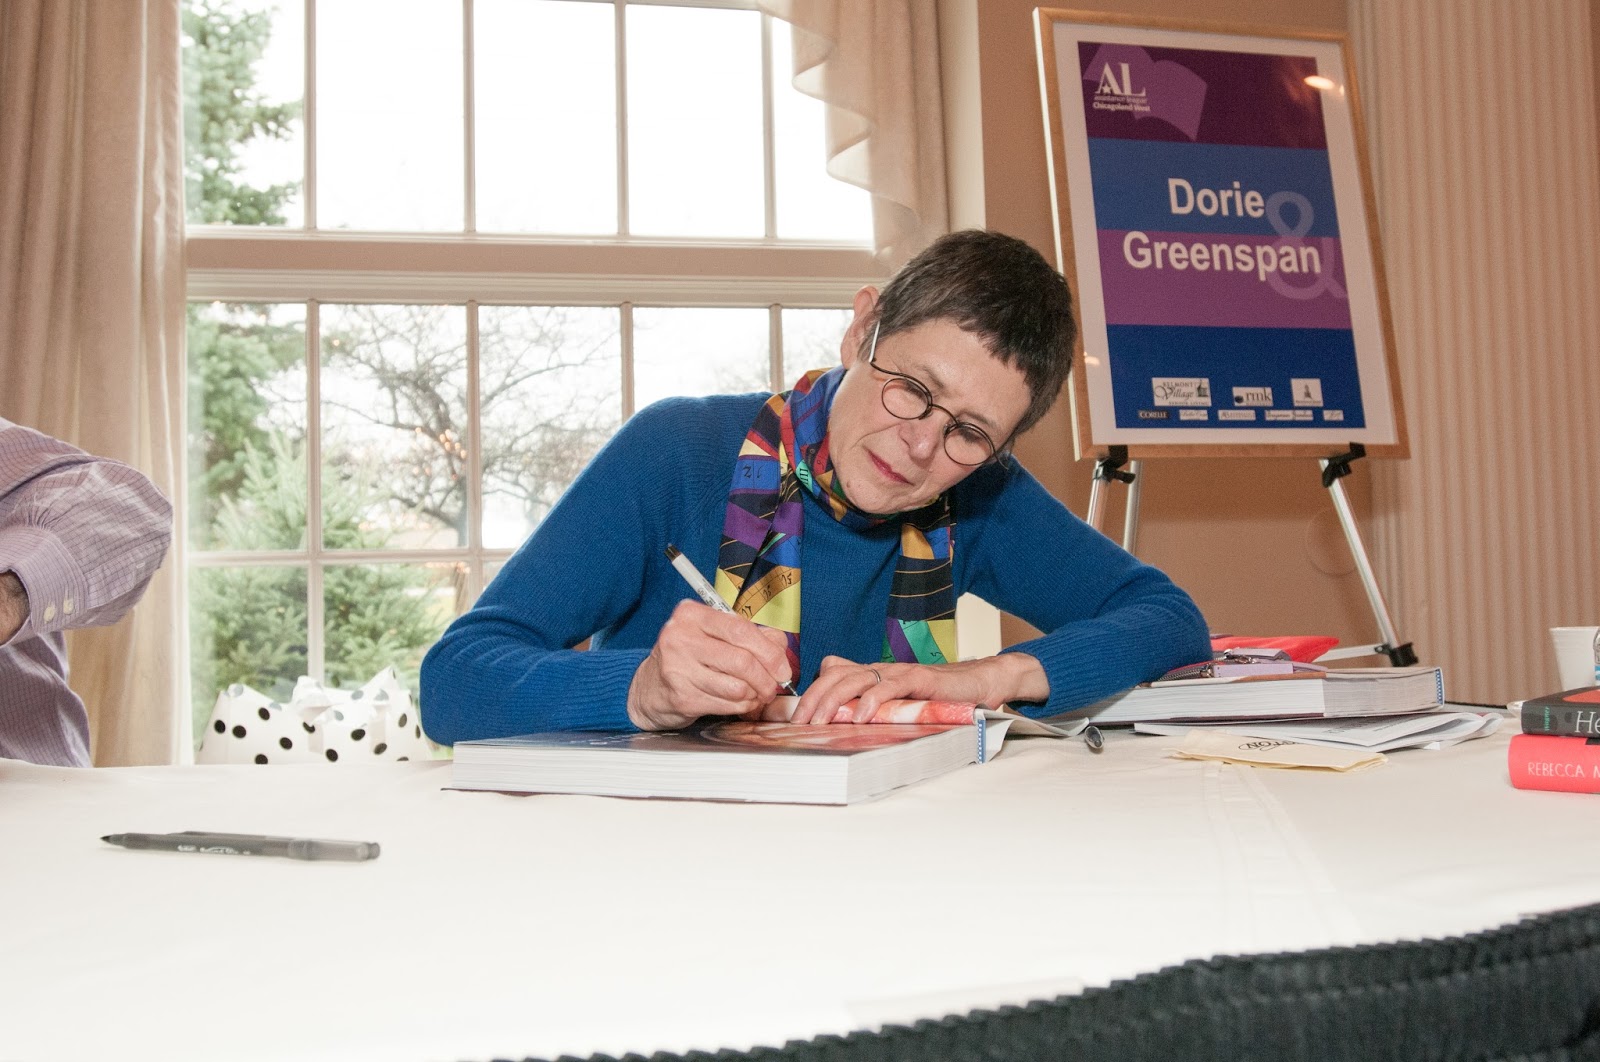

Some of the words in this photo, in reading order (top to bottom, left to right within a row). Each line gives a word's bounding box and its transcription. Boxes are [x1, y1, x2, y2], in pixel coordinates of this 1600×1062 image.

[1094, 62, 1146, 97] AL
[1167, 177, 1265, 219] Dorie
[1122, 230, 1322, 281] Greenspan
[1155, 385, 1195, 401] Village
[1245, 387, 1272, 402] rmk
[1528, 762, 1585, 778] REBECCA
